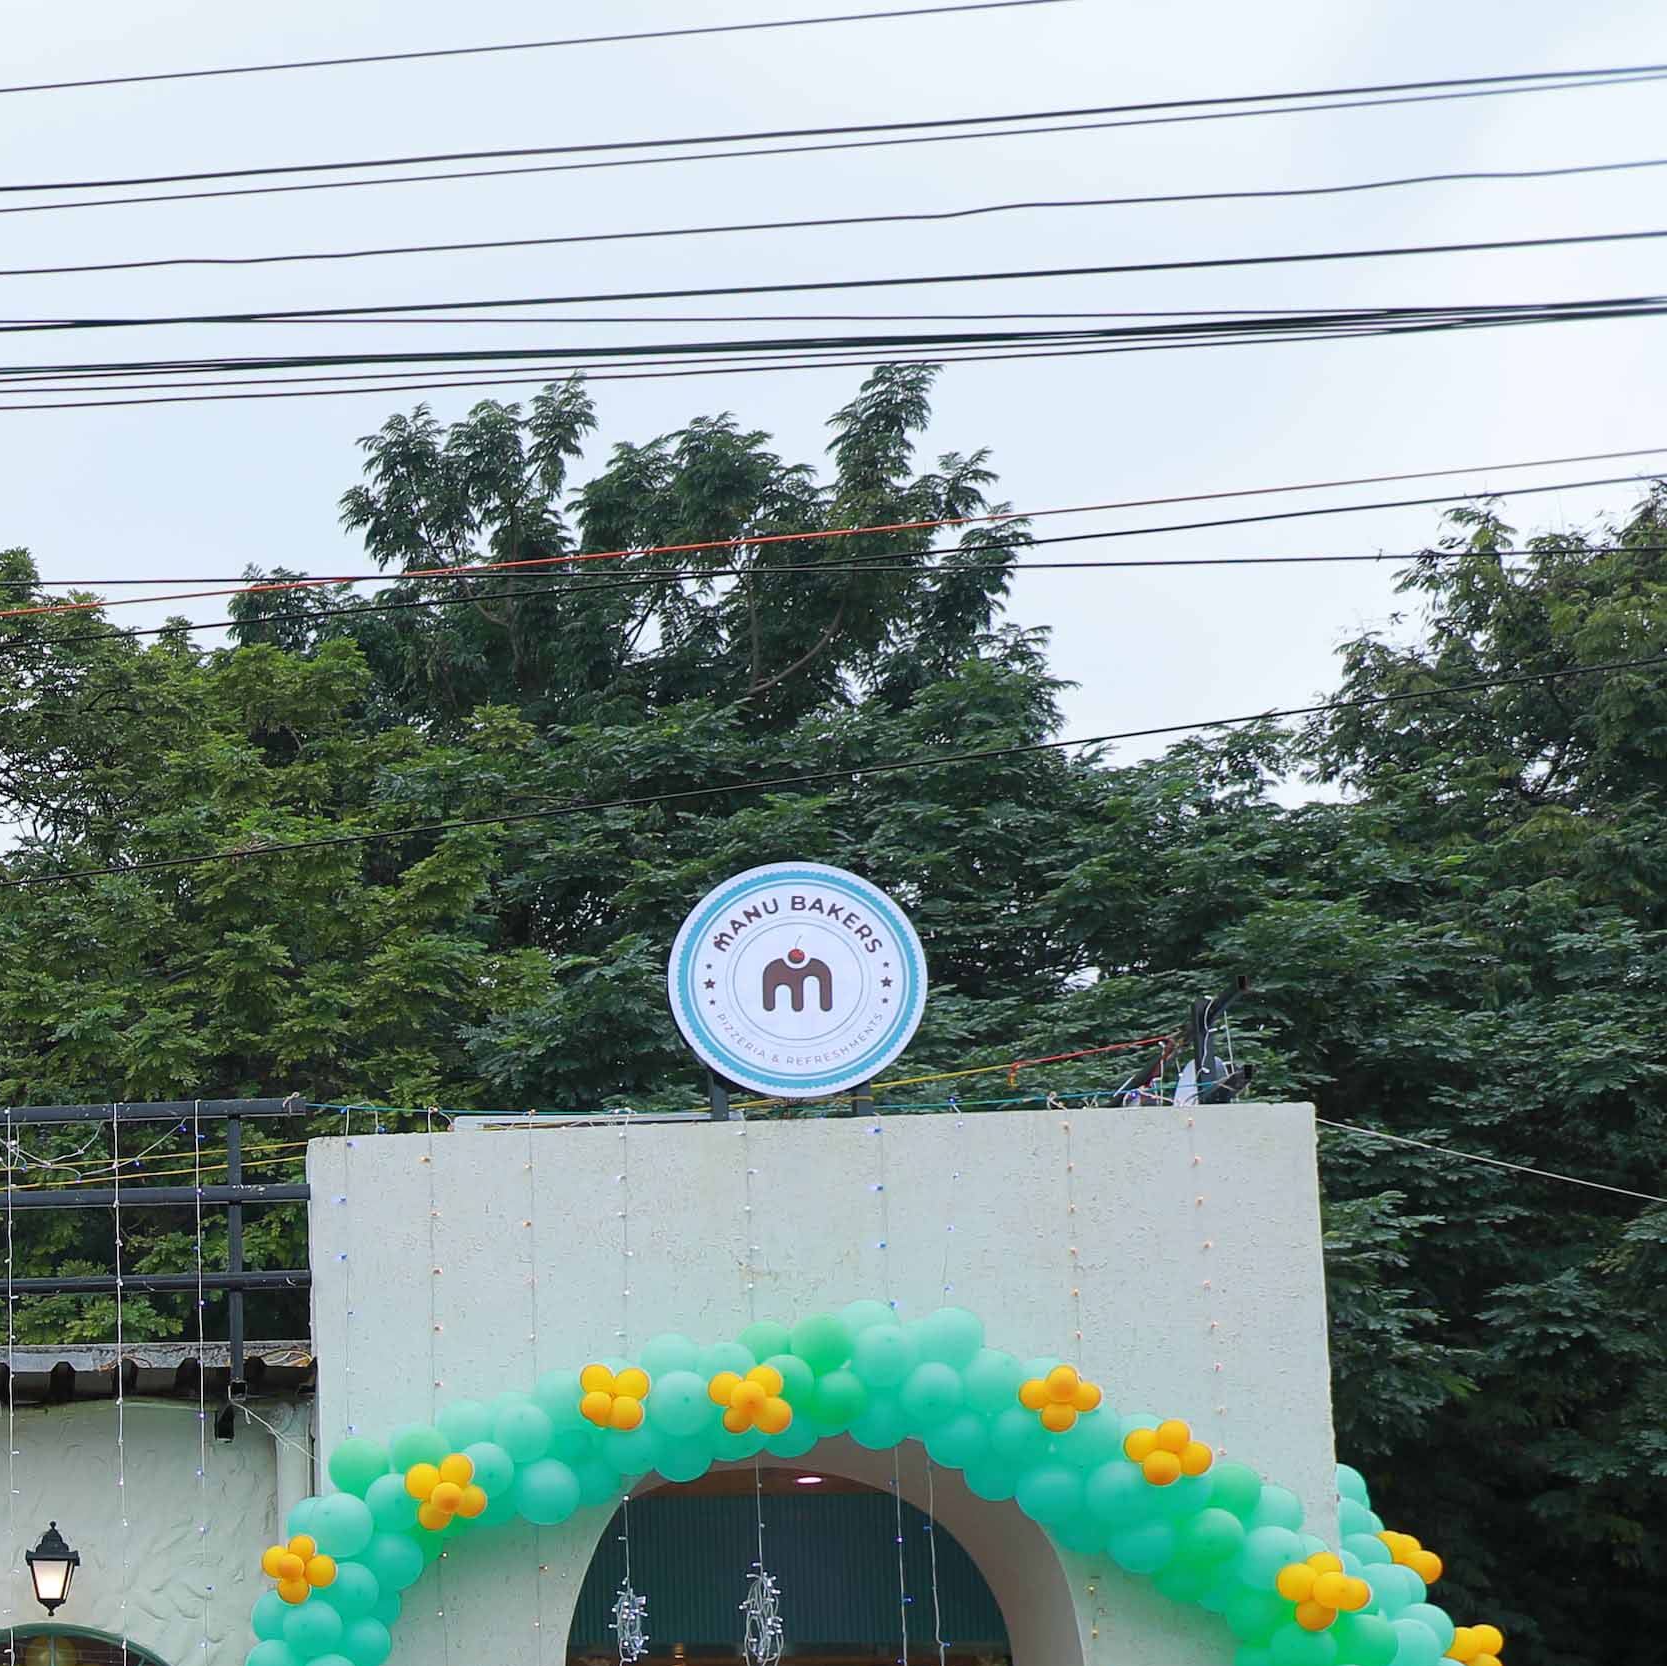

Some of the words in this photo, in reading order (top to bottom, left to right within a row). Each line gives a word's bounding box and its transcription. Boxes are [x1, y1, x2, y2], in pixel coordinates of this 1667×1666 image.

[713, 897, 780, 952] MANU
[791, 895, 883, 954] BAKERS
[717, 1012, 766, 1059] PIZZERIA
[771, 1054, 780, 1063] &
[785, 1012, 884, 1066] REFRESHMENTS
